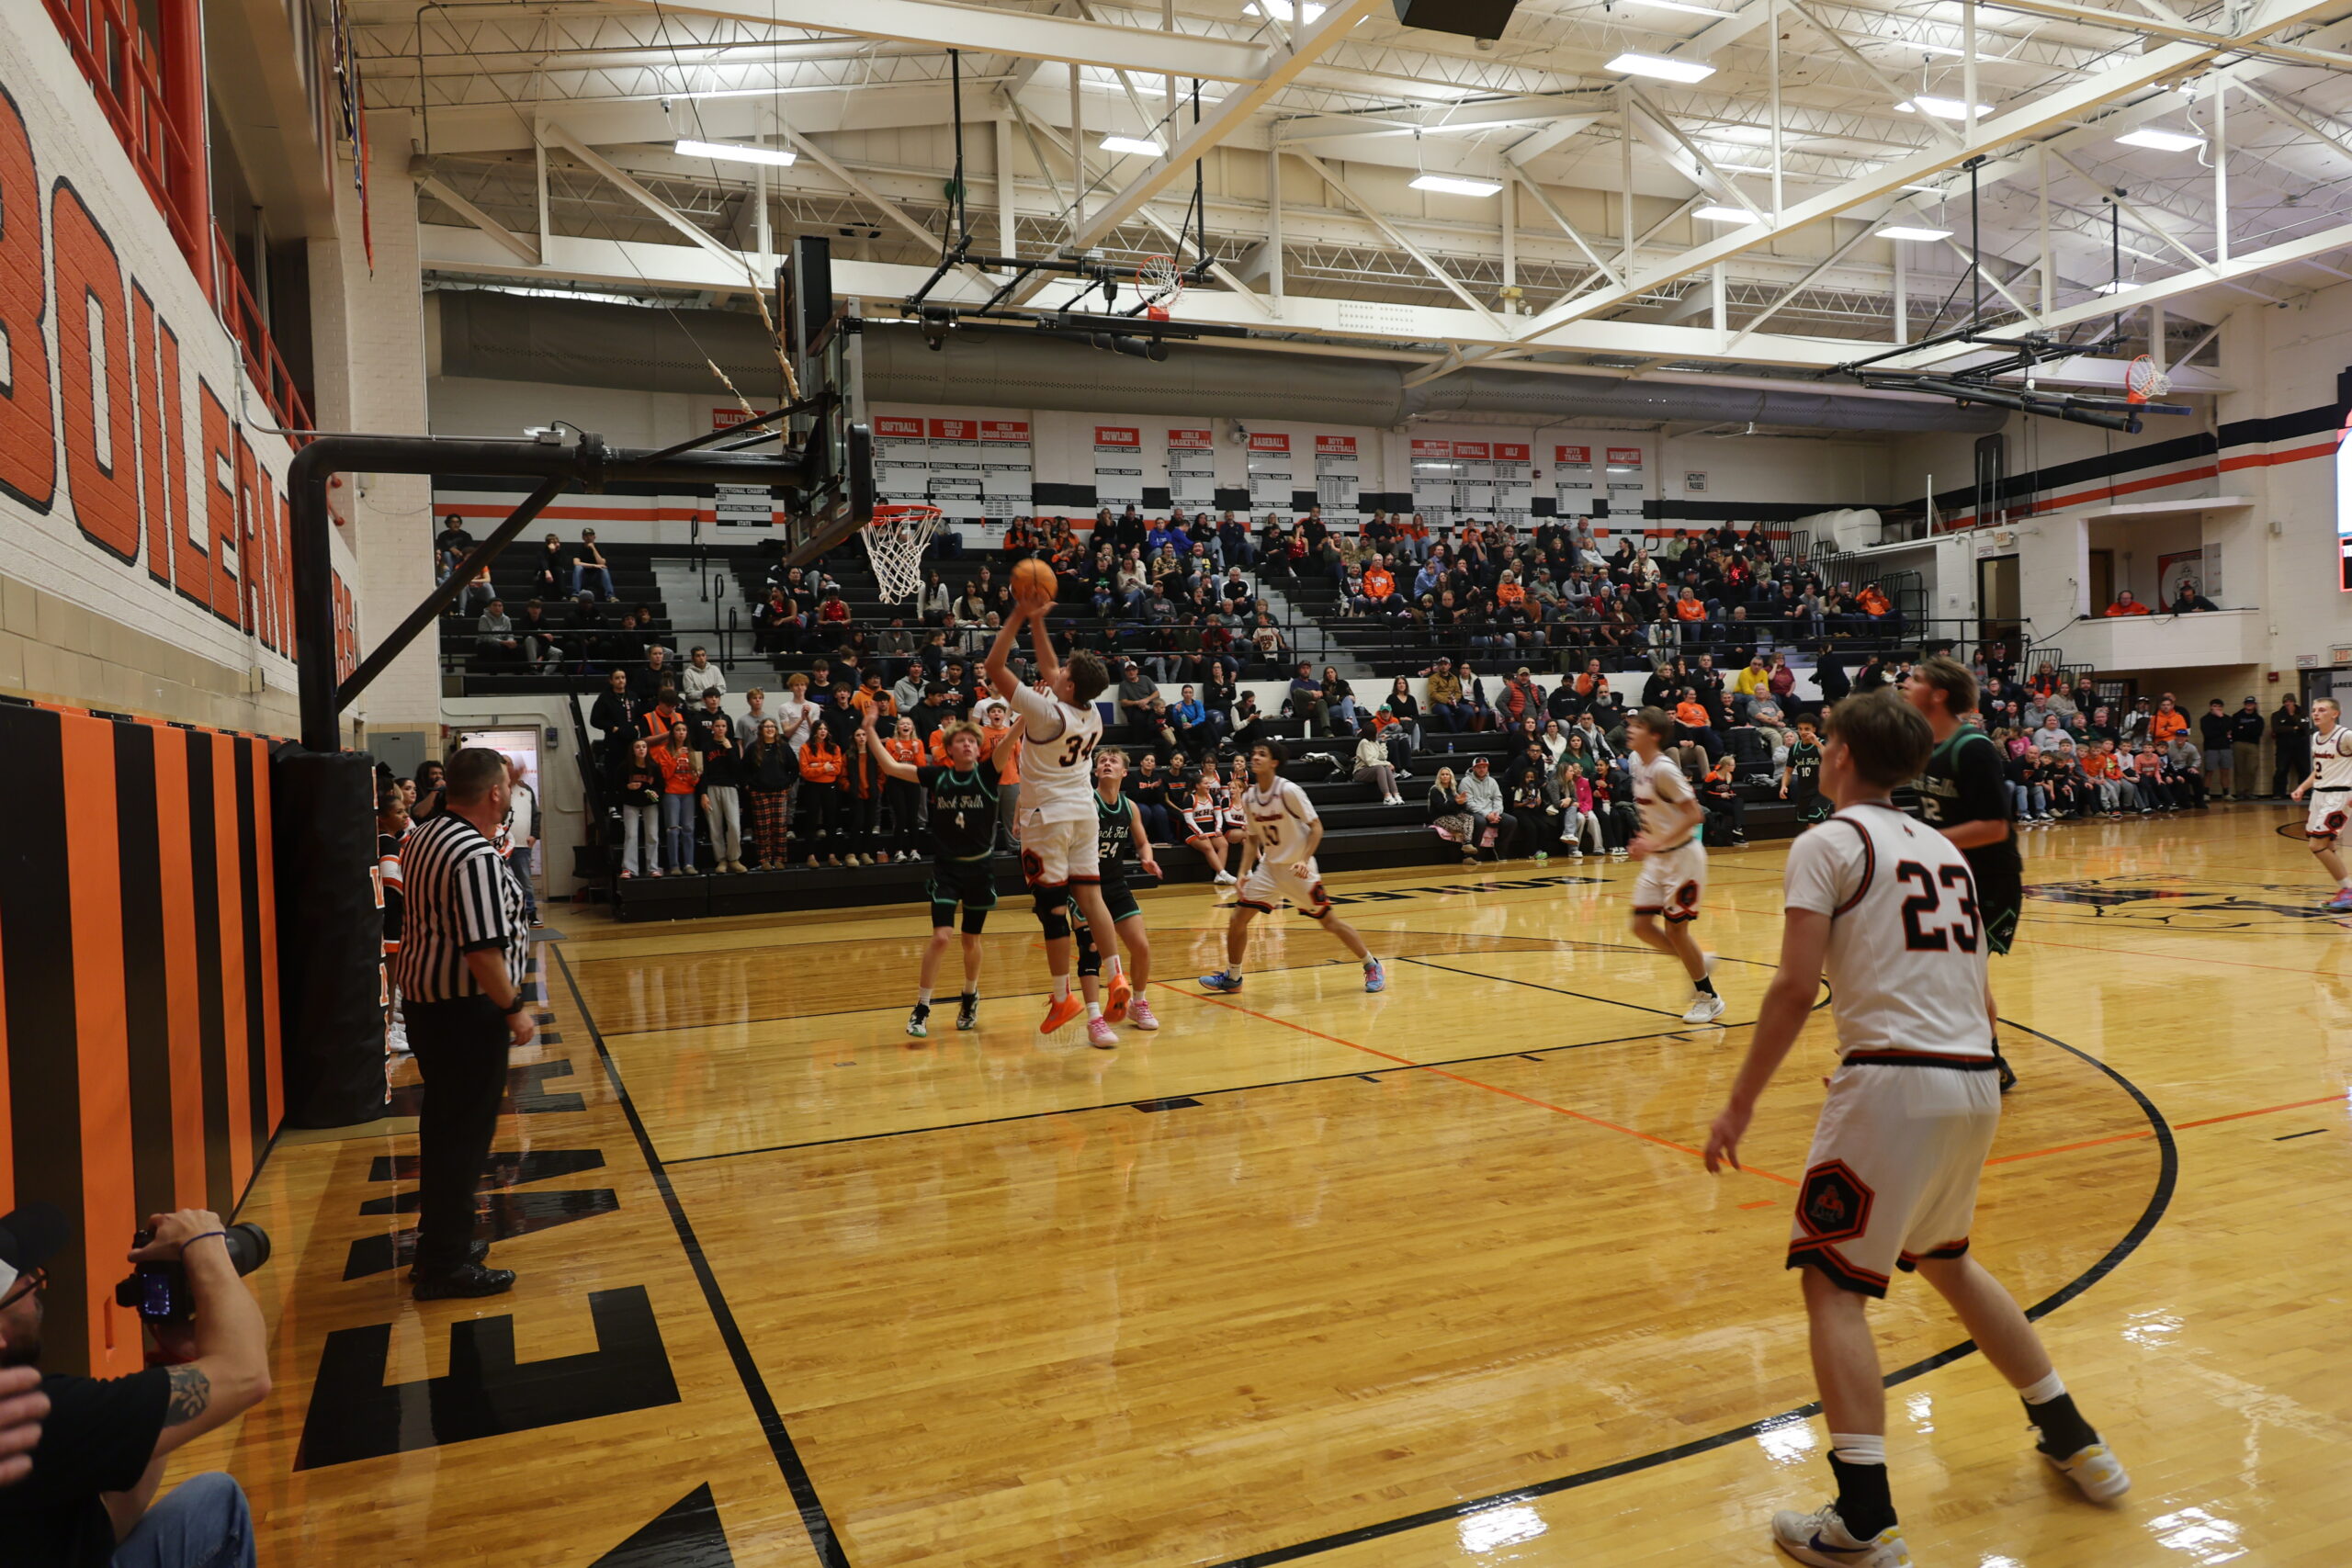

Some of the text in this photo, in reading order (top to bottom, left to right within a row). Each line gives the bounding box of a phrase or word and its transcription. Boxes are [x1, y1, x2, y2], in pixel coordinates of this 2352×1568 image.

[881, 421, 918, 433] SOFTBALL
[943, 421, 963, 429] GIRLS
[944, 429, 962, 437] GOLF
[1001, 431, 1028, 439] COUNTRY
[1102, 431, 1133, 442] BOWLING
[1170, 439, 1211, 447] BASKETBALL
[1253, 437, 1284, 447] BASEBALL
[1457, 446, 1485, 456] FOOTBALL
[1505, 447, 1518, 457] GOLF
[1687, 473, 1705, 481] ACTIVITY
[1689, 481, 1704, 490] PASSES
[1058, 731, 1098, 768] 34
[1802, 767, 1812, 777] 10
[959, 795, 984, 809] Falls
[956, 811, 965, 829] 4
[1099, 826, 1113, 838] ock
[1099, 841, 1119, 859] 24
[1895, 859, 1980, 954] 23
